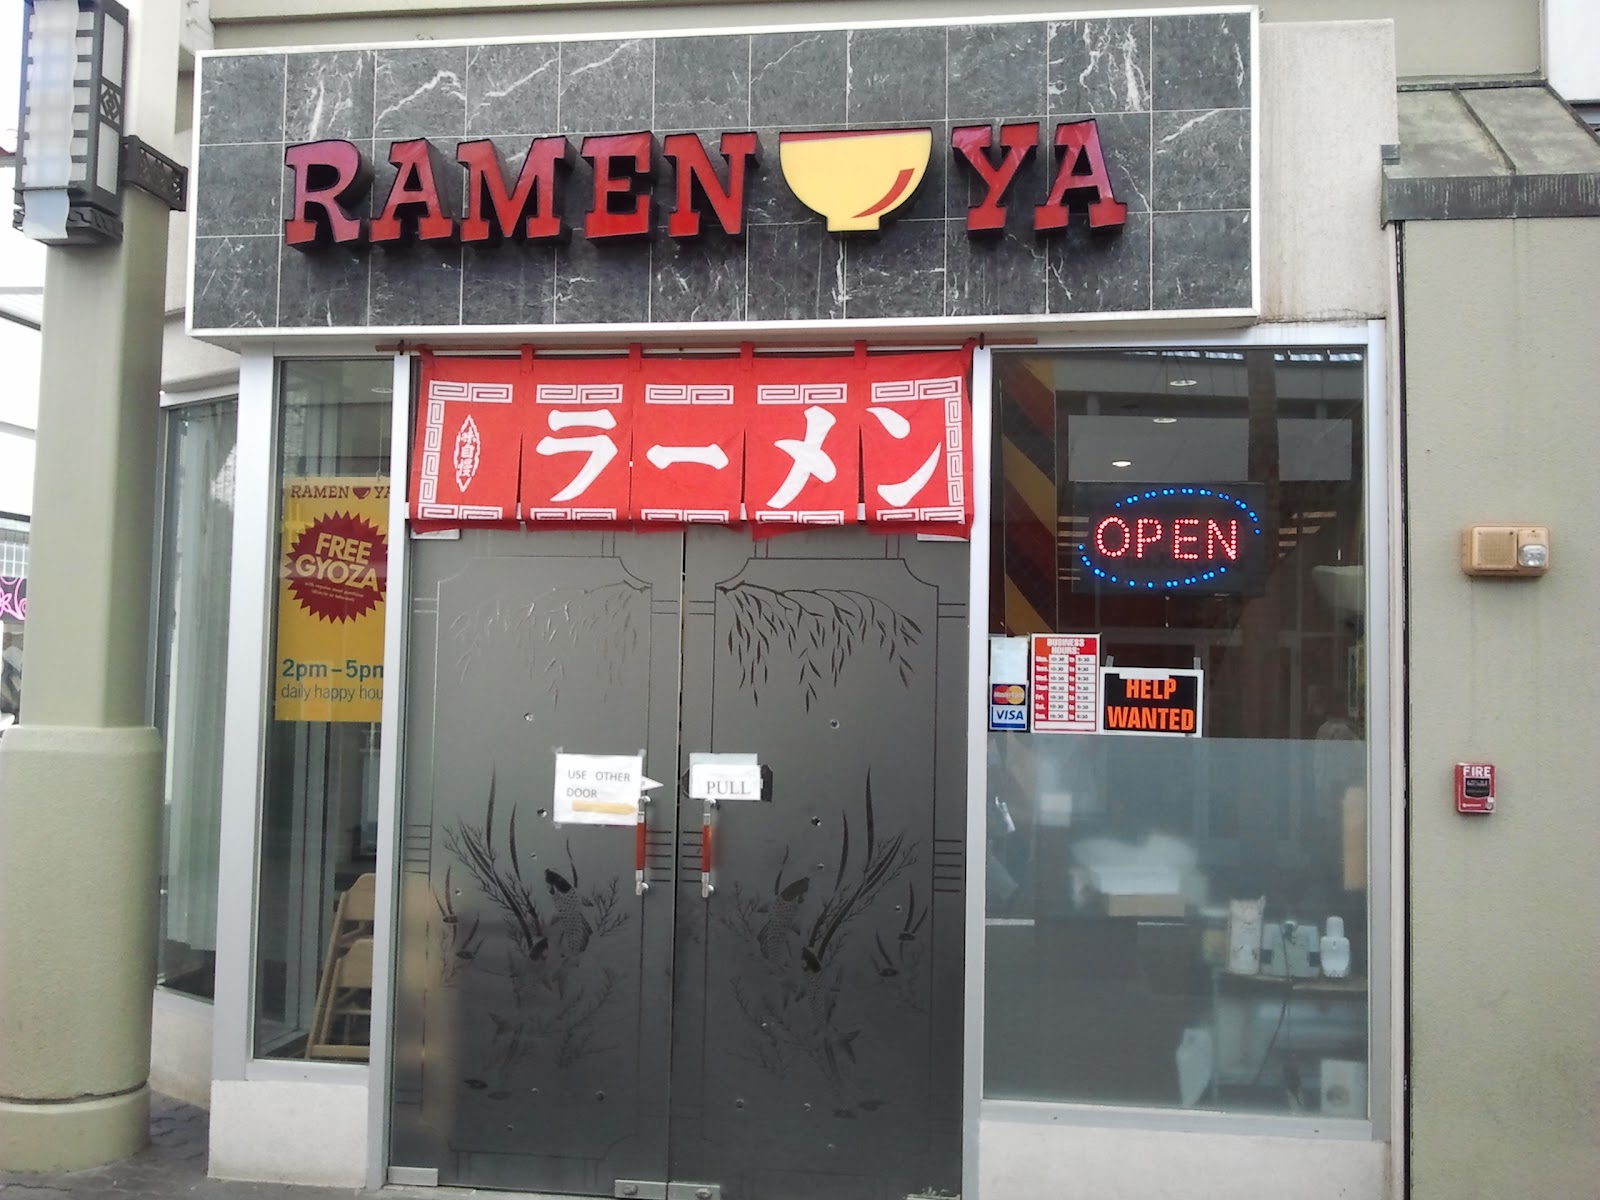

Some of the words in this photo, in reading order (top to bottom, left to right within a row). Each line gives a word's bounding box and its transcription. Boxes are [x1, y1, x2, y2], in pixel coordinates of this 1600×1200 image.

[284, 131, 761, 243] RAMEN
[952, 119, 1127, 232] YA
[535, 405, 942, 508] ラーメン
[291, 485, 349, 498] RAMEN
[1096, 516, 1237, 560] OPEN
[315, 532, 373, 565] FREE
[295, 554, 379, 592] GYOZA
[1047, 638, 1085, 647] BUSINESS
[1051, 647, 1080, 655] HOURS:
[282, 658, 327, 681] 2pm
[281, 684, 311, 701] daily
[314, 684, 355, 702] happy
[360, 685, 384, 700] hou
[1126, 678, 1177, 700] HELP
[996, 710, 1024, 720] VISA
[1107, 706, 1194, 731] WANTED
[568, 769, 587, 780] USE
[595, 770, 631, 782] OTHER
[1463, 766, 1492, 777] FIRE
[566, 787, 597, 798] DOOR
[706, 780, 751, 796] PULL
